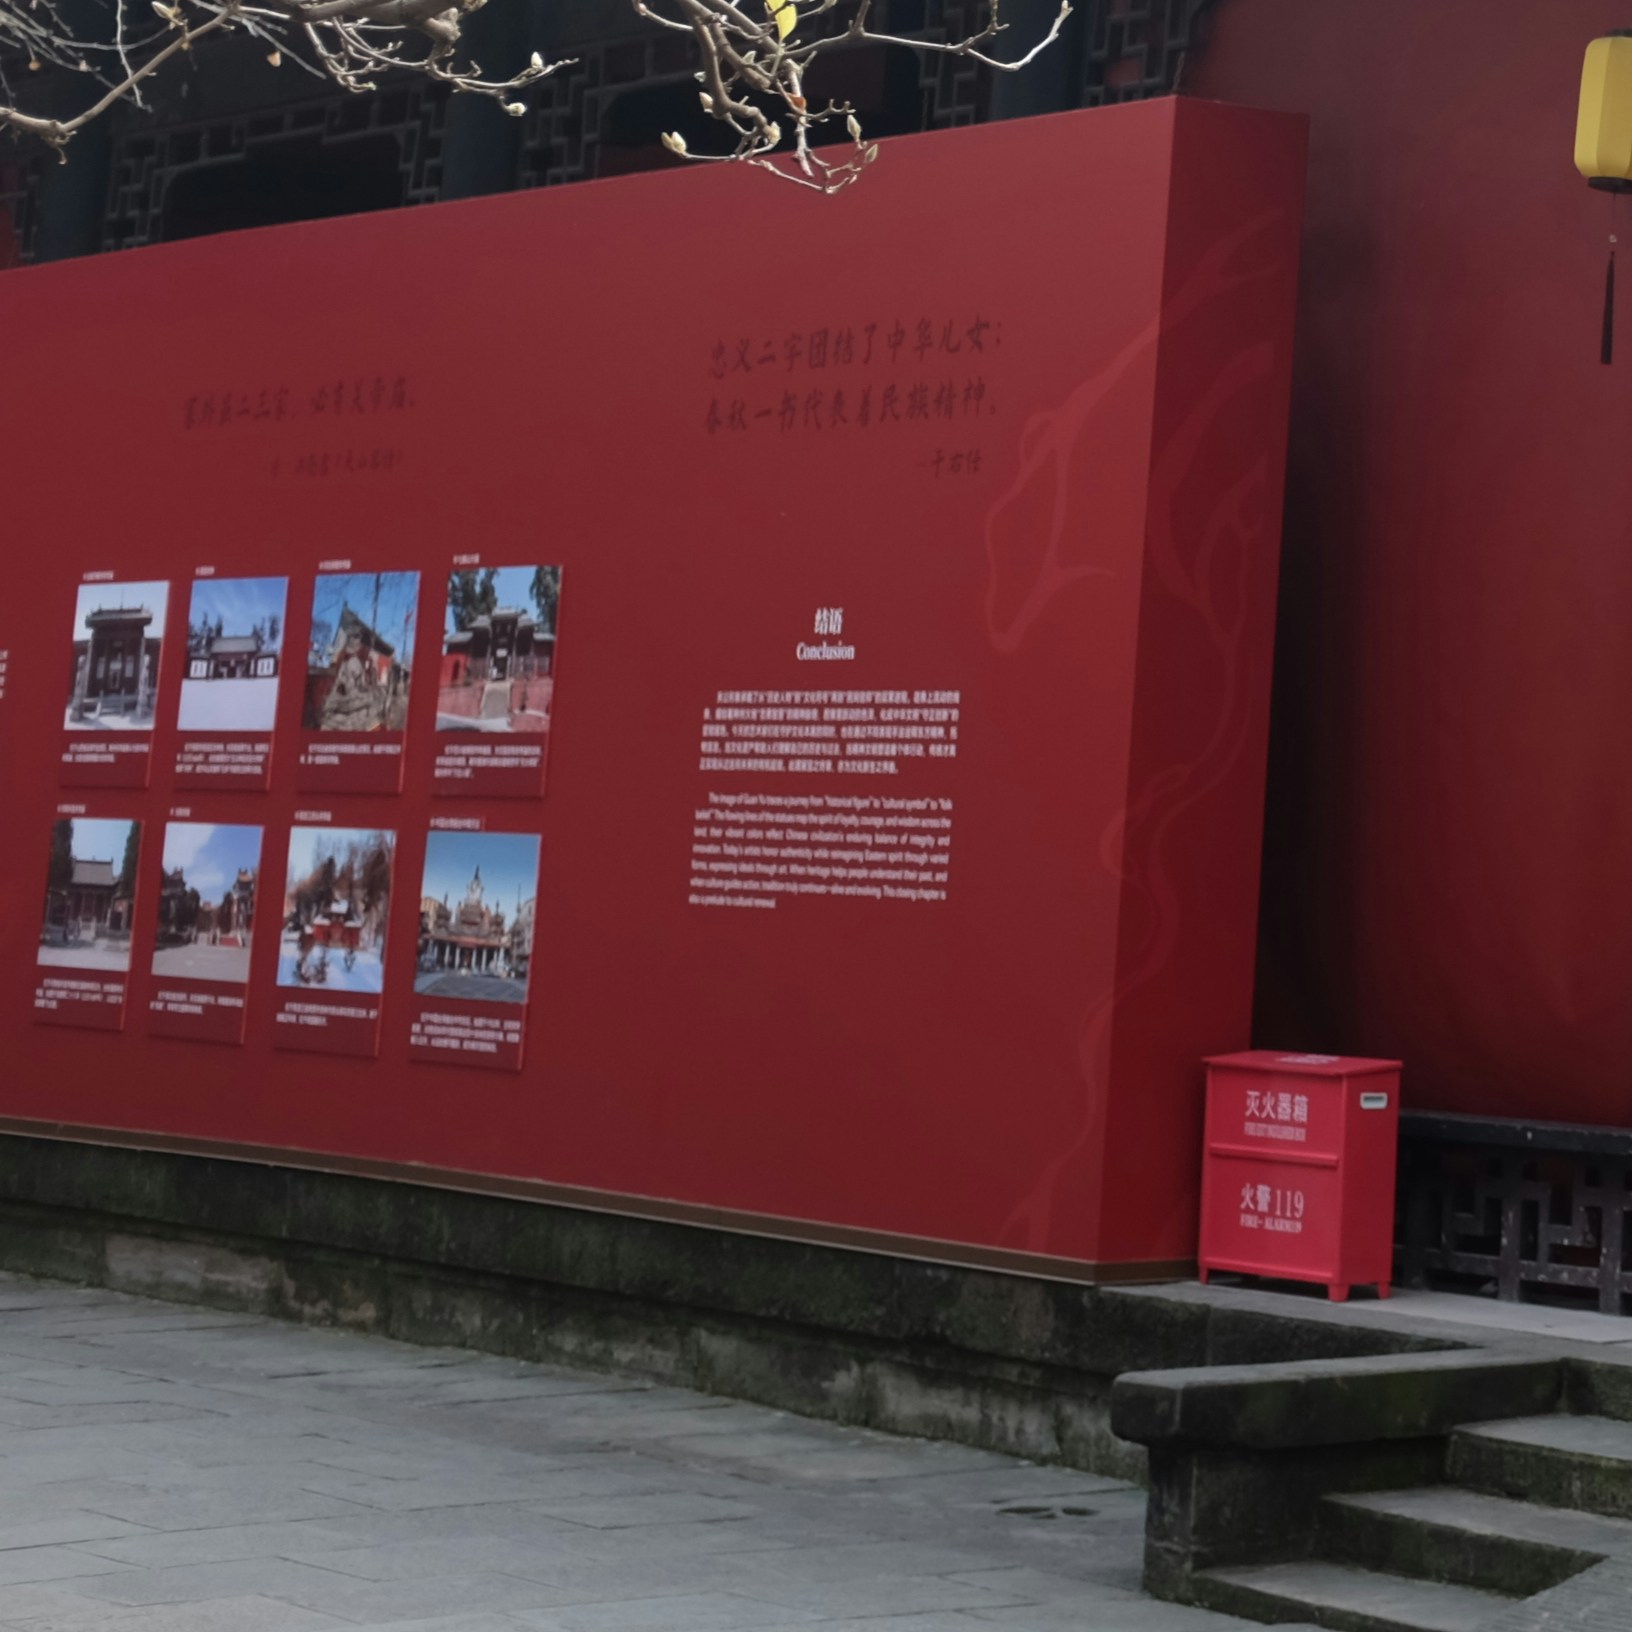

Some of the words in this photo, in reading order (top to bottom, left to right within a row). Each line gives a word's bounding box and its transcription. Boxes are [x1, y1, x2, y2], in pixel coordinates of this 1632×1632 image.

[814, 607, 844, 635] 结语
[796, 642, 855, 661] Conclusion
[1245, 1090, 1309, 1125] 灭火器箱
[1240, 1183, 1271, 1213] 火警
[1275, 1189, 1304, 1218] 119
